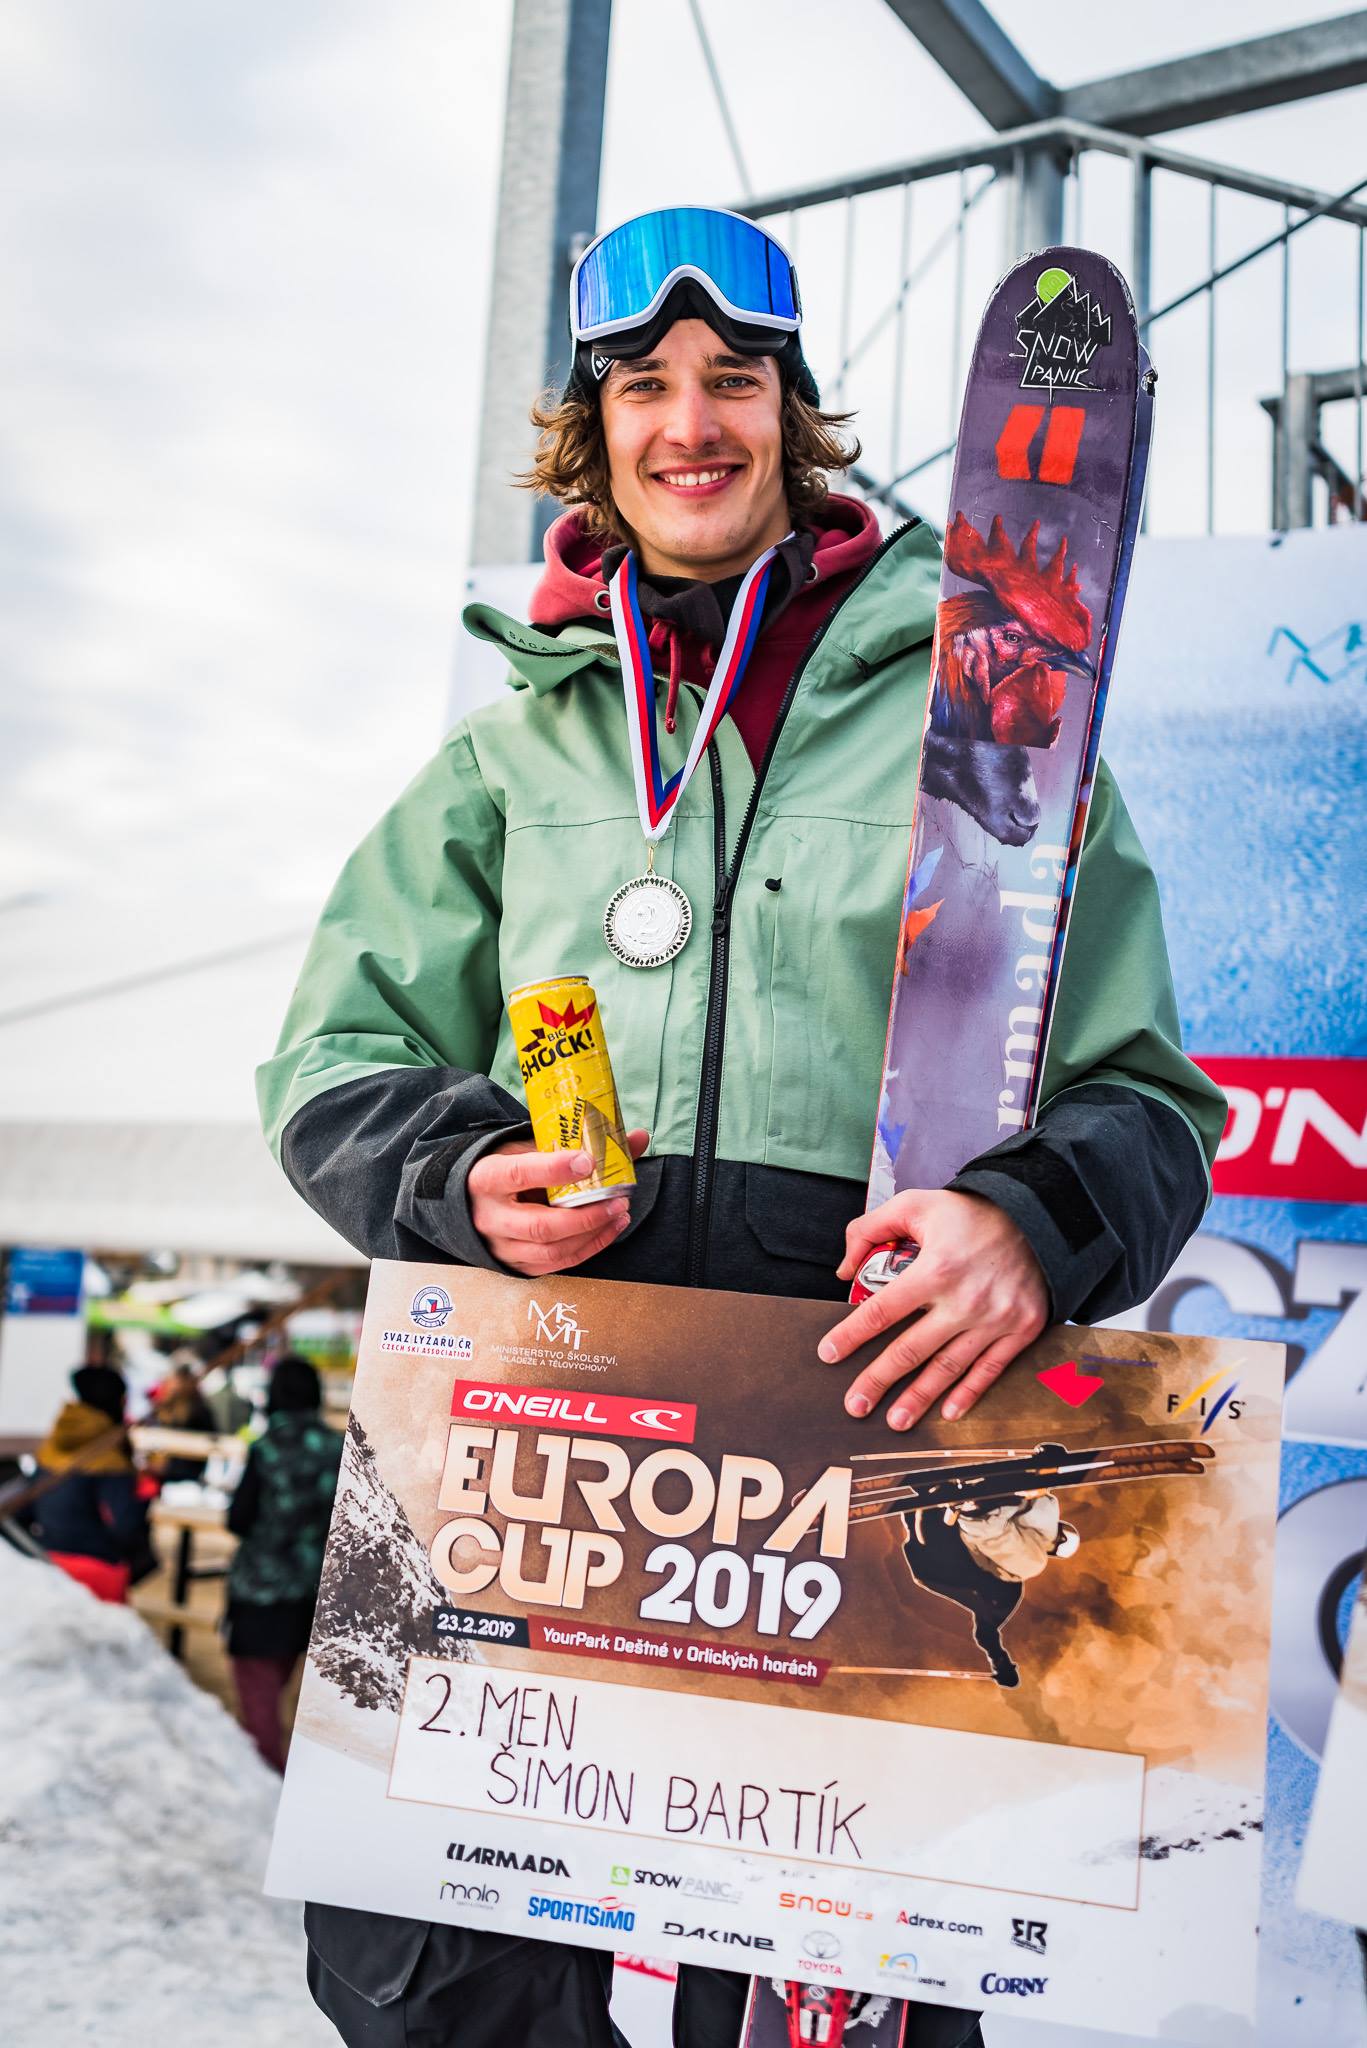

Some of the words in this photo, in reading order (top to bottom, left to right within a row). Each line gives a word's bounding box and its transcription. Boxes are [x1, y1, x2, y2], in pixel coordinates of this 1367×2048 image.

[1008, 330, 1098, 365] SNOW
[1030, 364, 1089, 389] PANIC
[547, 1027, 567, 1042] BIG
[521, 1028, 596, 1085] SHOCK!
[381, 1343, 405, 1352] CZECH
[407, 1345, 419, 1353] SKI
[421, 1347, 471, 1358] ASSOCIATION
[383, 1332, 410, 1343] SVAZ
[491, 1343, 564, 1360] MINISTERSTVO
[462, 1388, 609, 1425] O'NEILL
[1166, 1393, 1242, 1420] FIS
[437, 1422, 853, 1560] EUROPA
[430, 1516, 625, 1610] CUP
[639, 1543, 843, 1641] 2019
[436, 1613, 516, 1639] 23.2.2019
[543, 1626, 610, 1651] YourPark
[613, 1635, 668, 1659] Deštné
[672, 1646, 684, 1660] v
[686, 1645, 758, 1671] Orlických
[762, 1654, 818, 1678] horách
[486, 1742, 635, 1825] ŠIMON
[664, 1776, 867, 1859] BARTÍK
[463, 1846, 571, 1878] ARMADA
[662, 1921, 776, 1952] DAKINE
[896, 1910, 984, 1936] Adrex.com
[797, 1960, 843, 1976] TOYOTA
